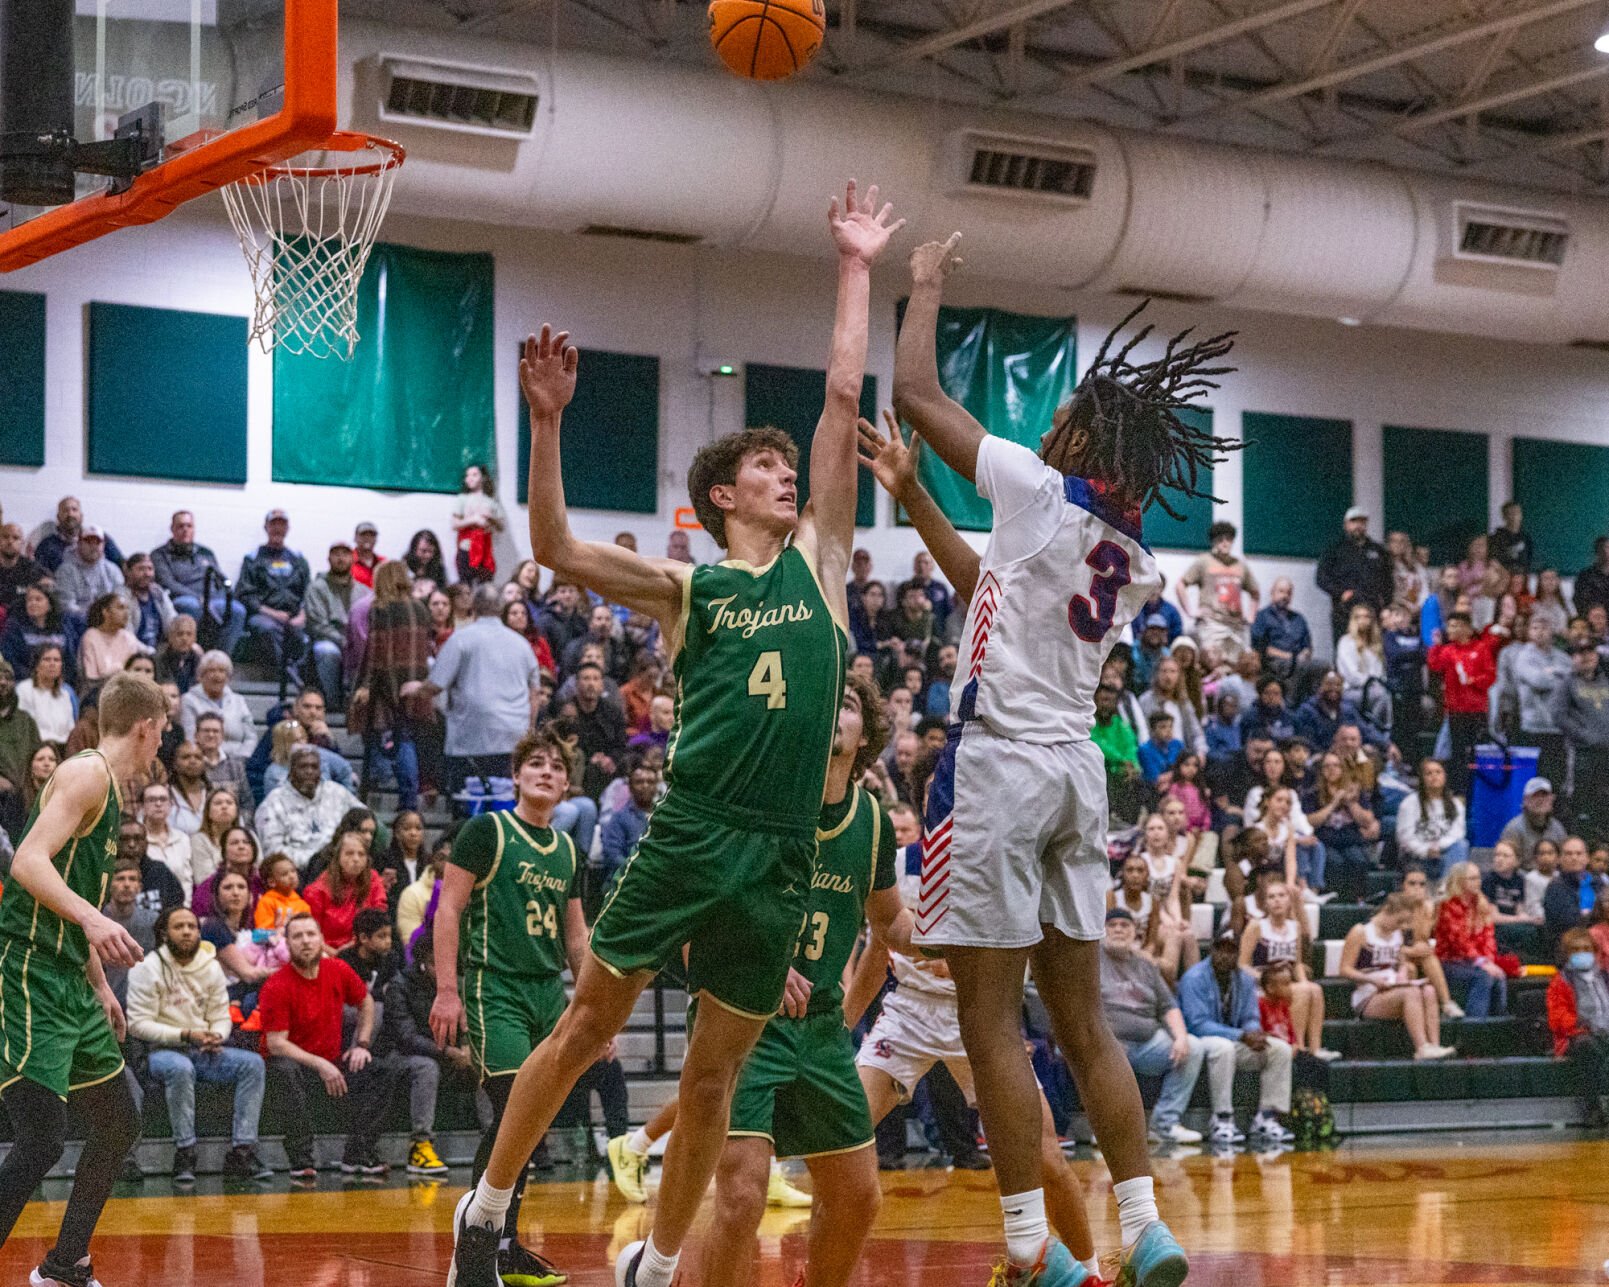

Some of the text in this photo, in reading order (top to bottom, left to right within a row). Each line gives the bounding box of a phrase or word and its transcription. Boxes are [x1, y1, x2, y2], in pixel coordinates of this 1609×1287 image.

[1068, 540, 1131, 642] 3
[707, 593, 813, 639] Trojans
[748, 650, 787, 710] 4
[516, 861, 567, 893] Trojans
[526, 900, 557, 939] 24
